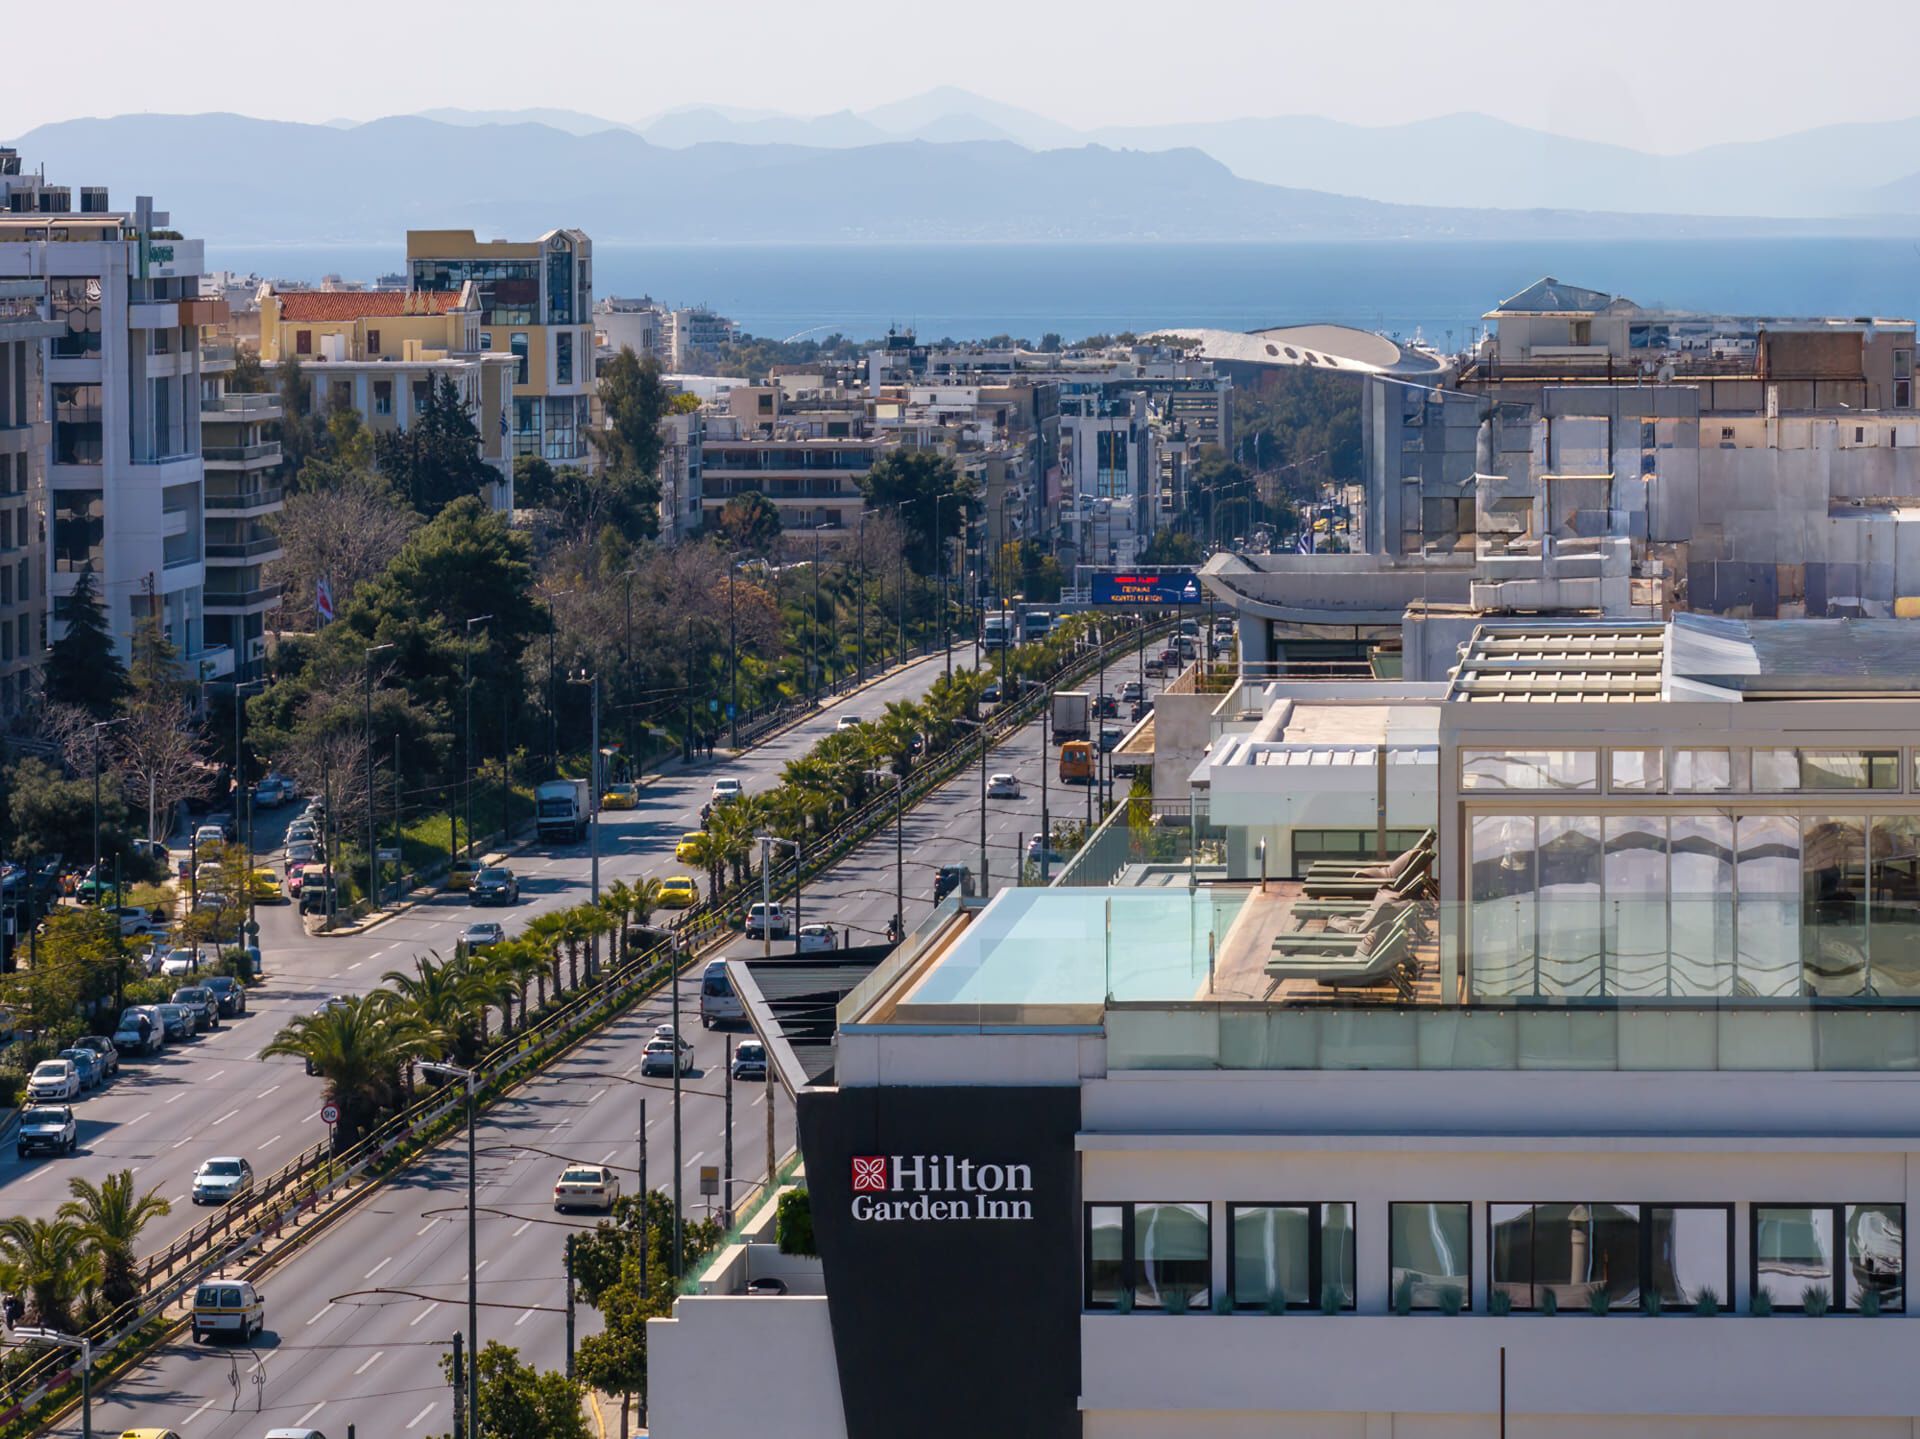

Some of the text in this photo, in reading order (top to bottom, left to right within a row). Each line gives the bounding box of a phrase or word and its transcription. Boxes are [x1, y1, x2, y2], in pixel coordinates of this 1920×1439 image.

[890, 1155, 1034, 1192] Hilton
[851, 1194, 1034, 1221] Garden Inn
